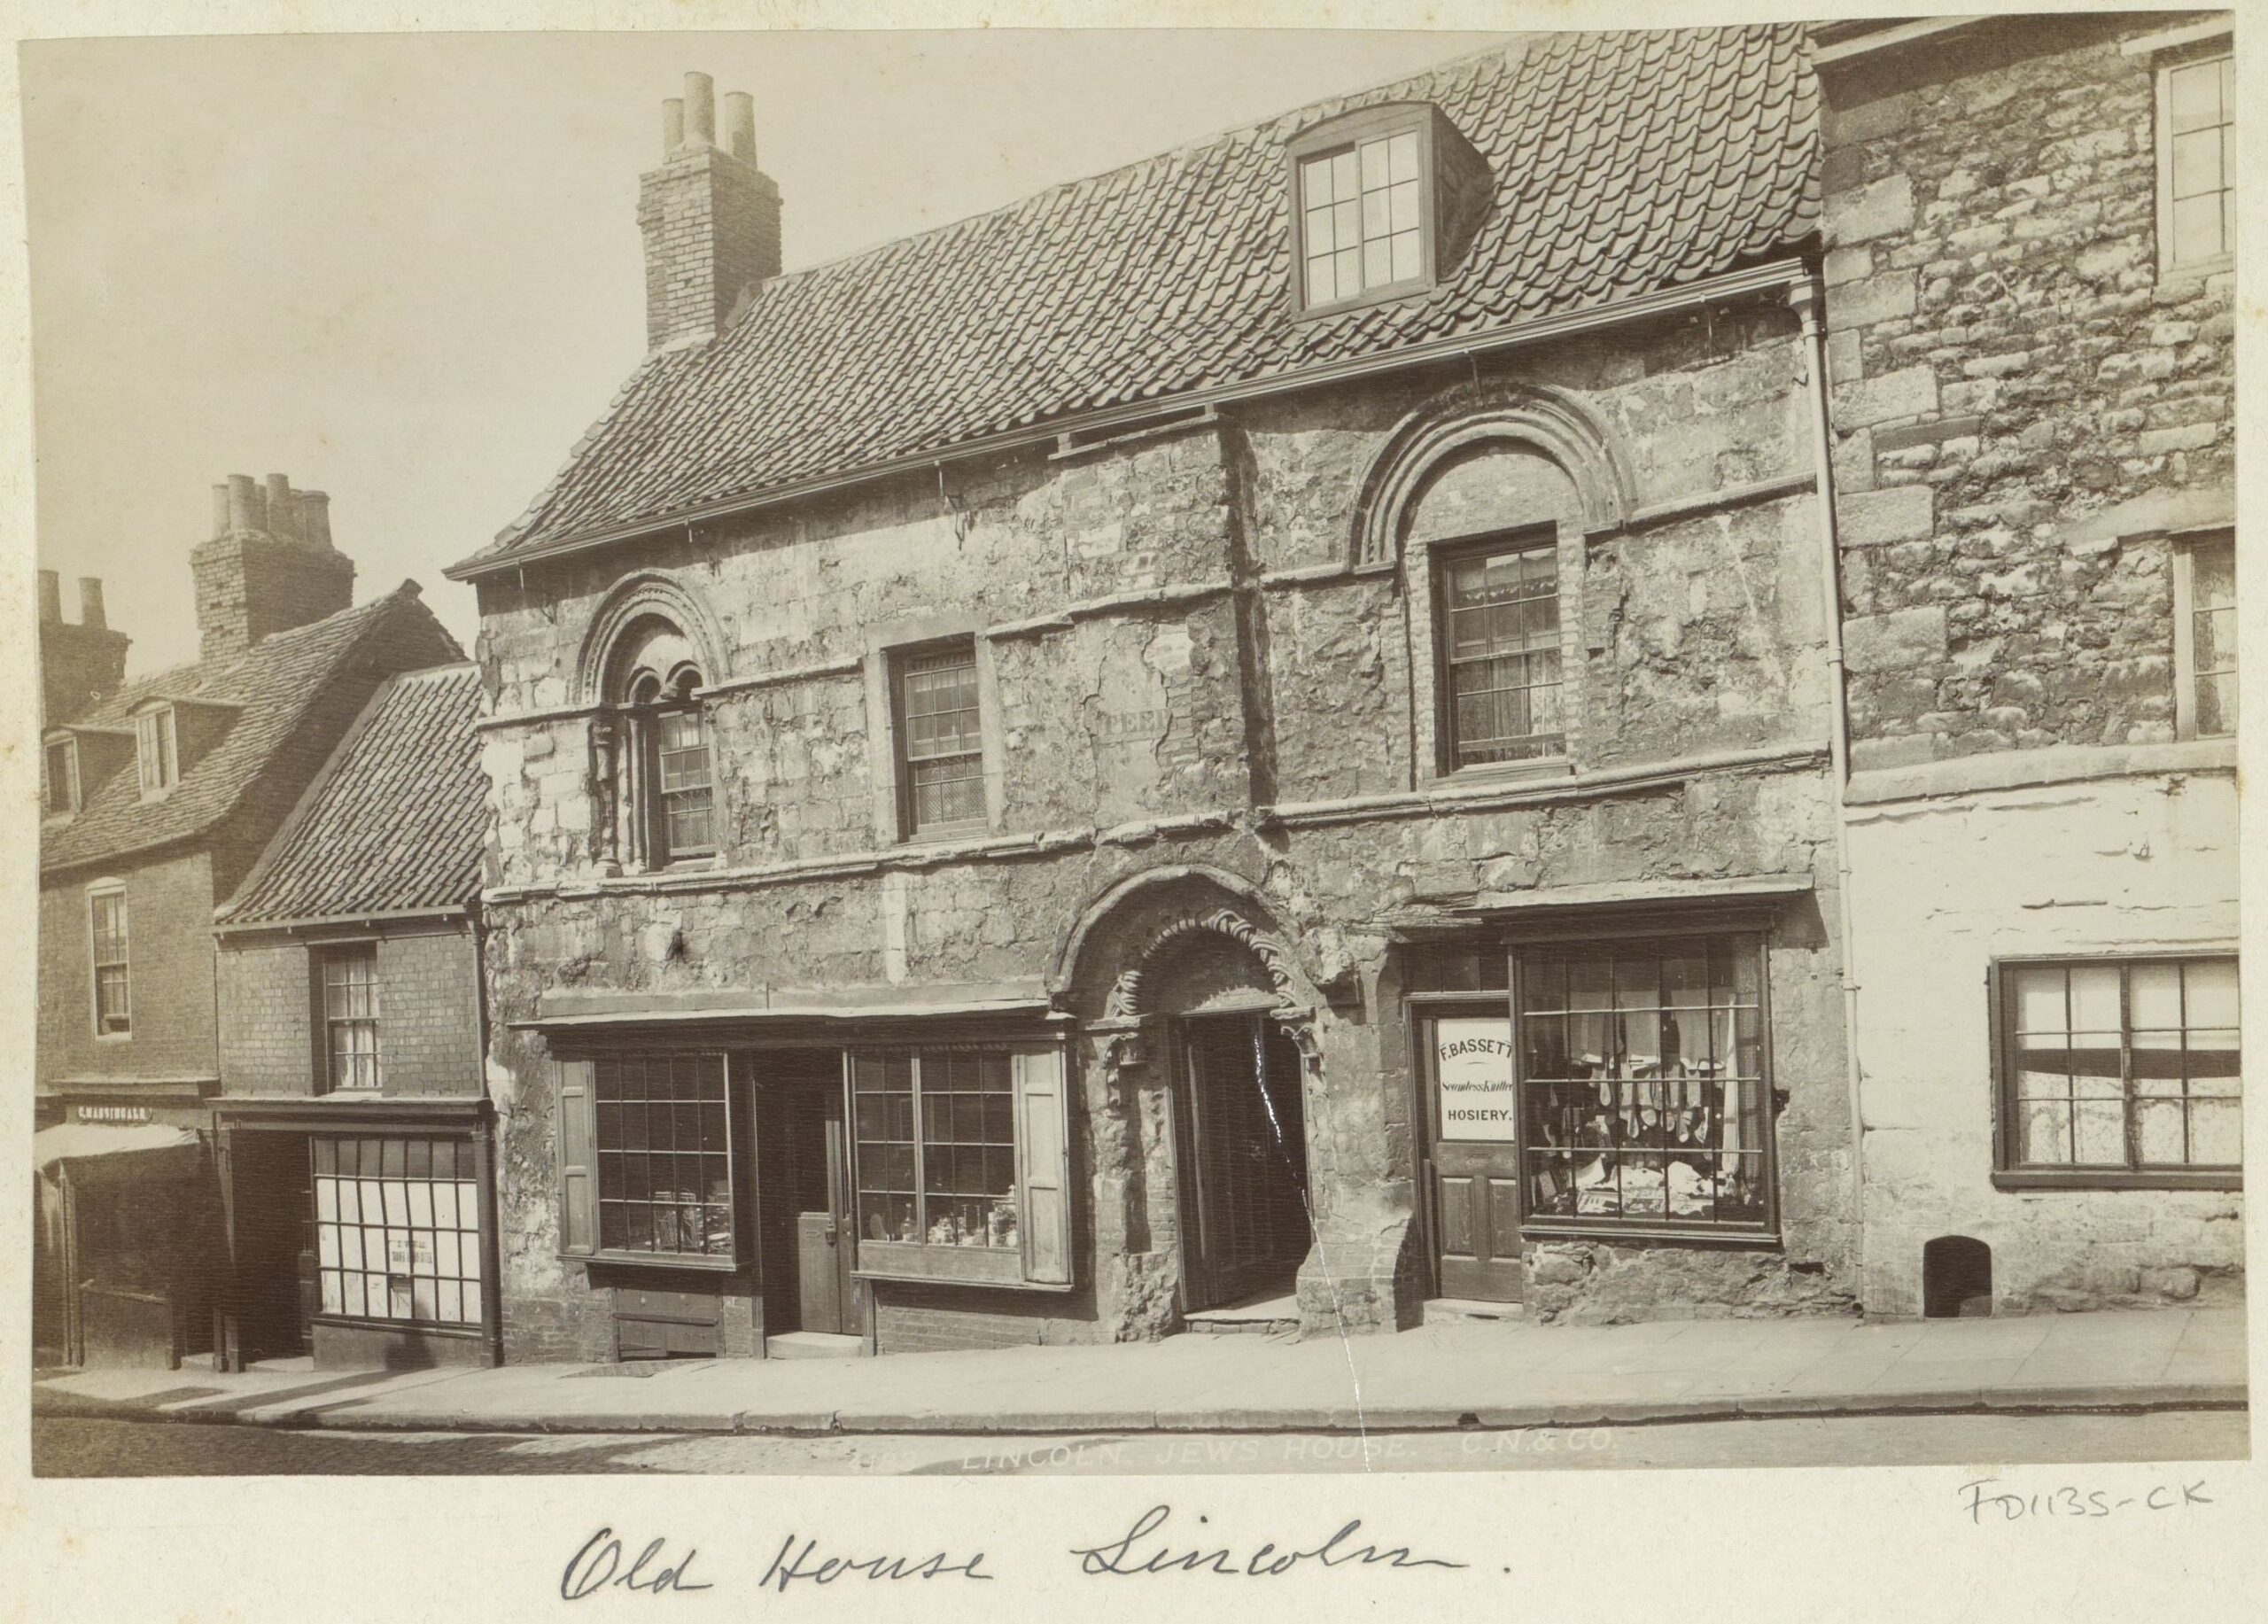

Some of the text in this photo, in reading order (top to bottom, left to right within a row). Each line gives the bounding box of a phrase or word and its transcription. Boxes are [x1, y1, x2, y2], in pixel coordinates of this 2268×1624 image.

[1448, 1109, 1512, 1122] HOSIERY.
[560, 1527, 713, 1601] Old
[758, 1534, 994, 1593] House
